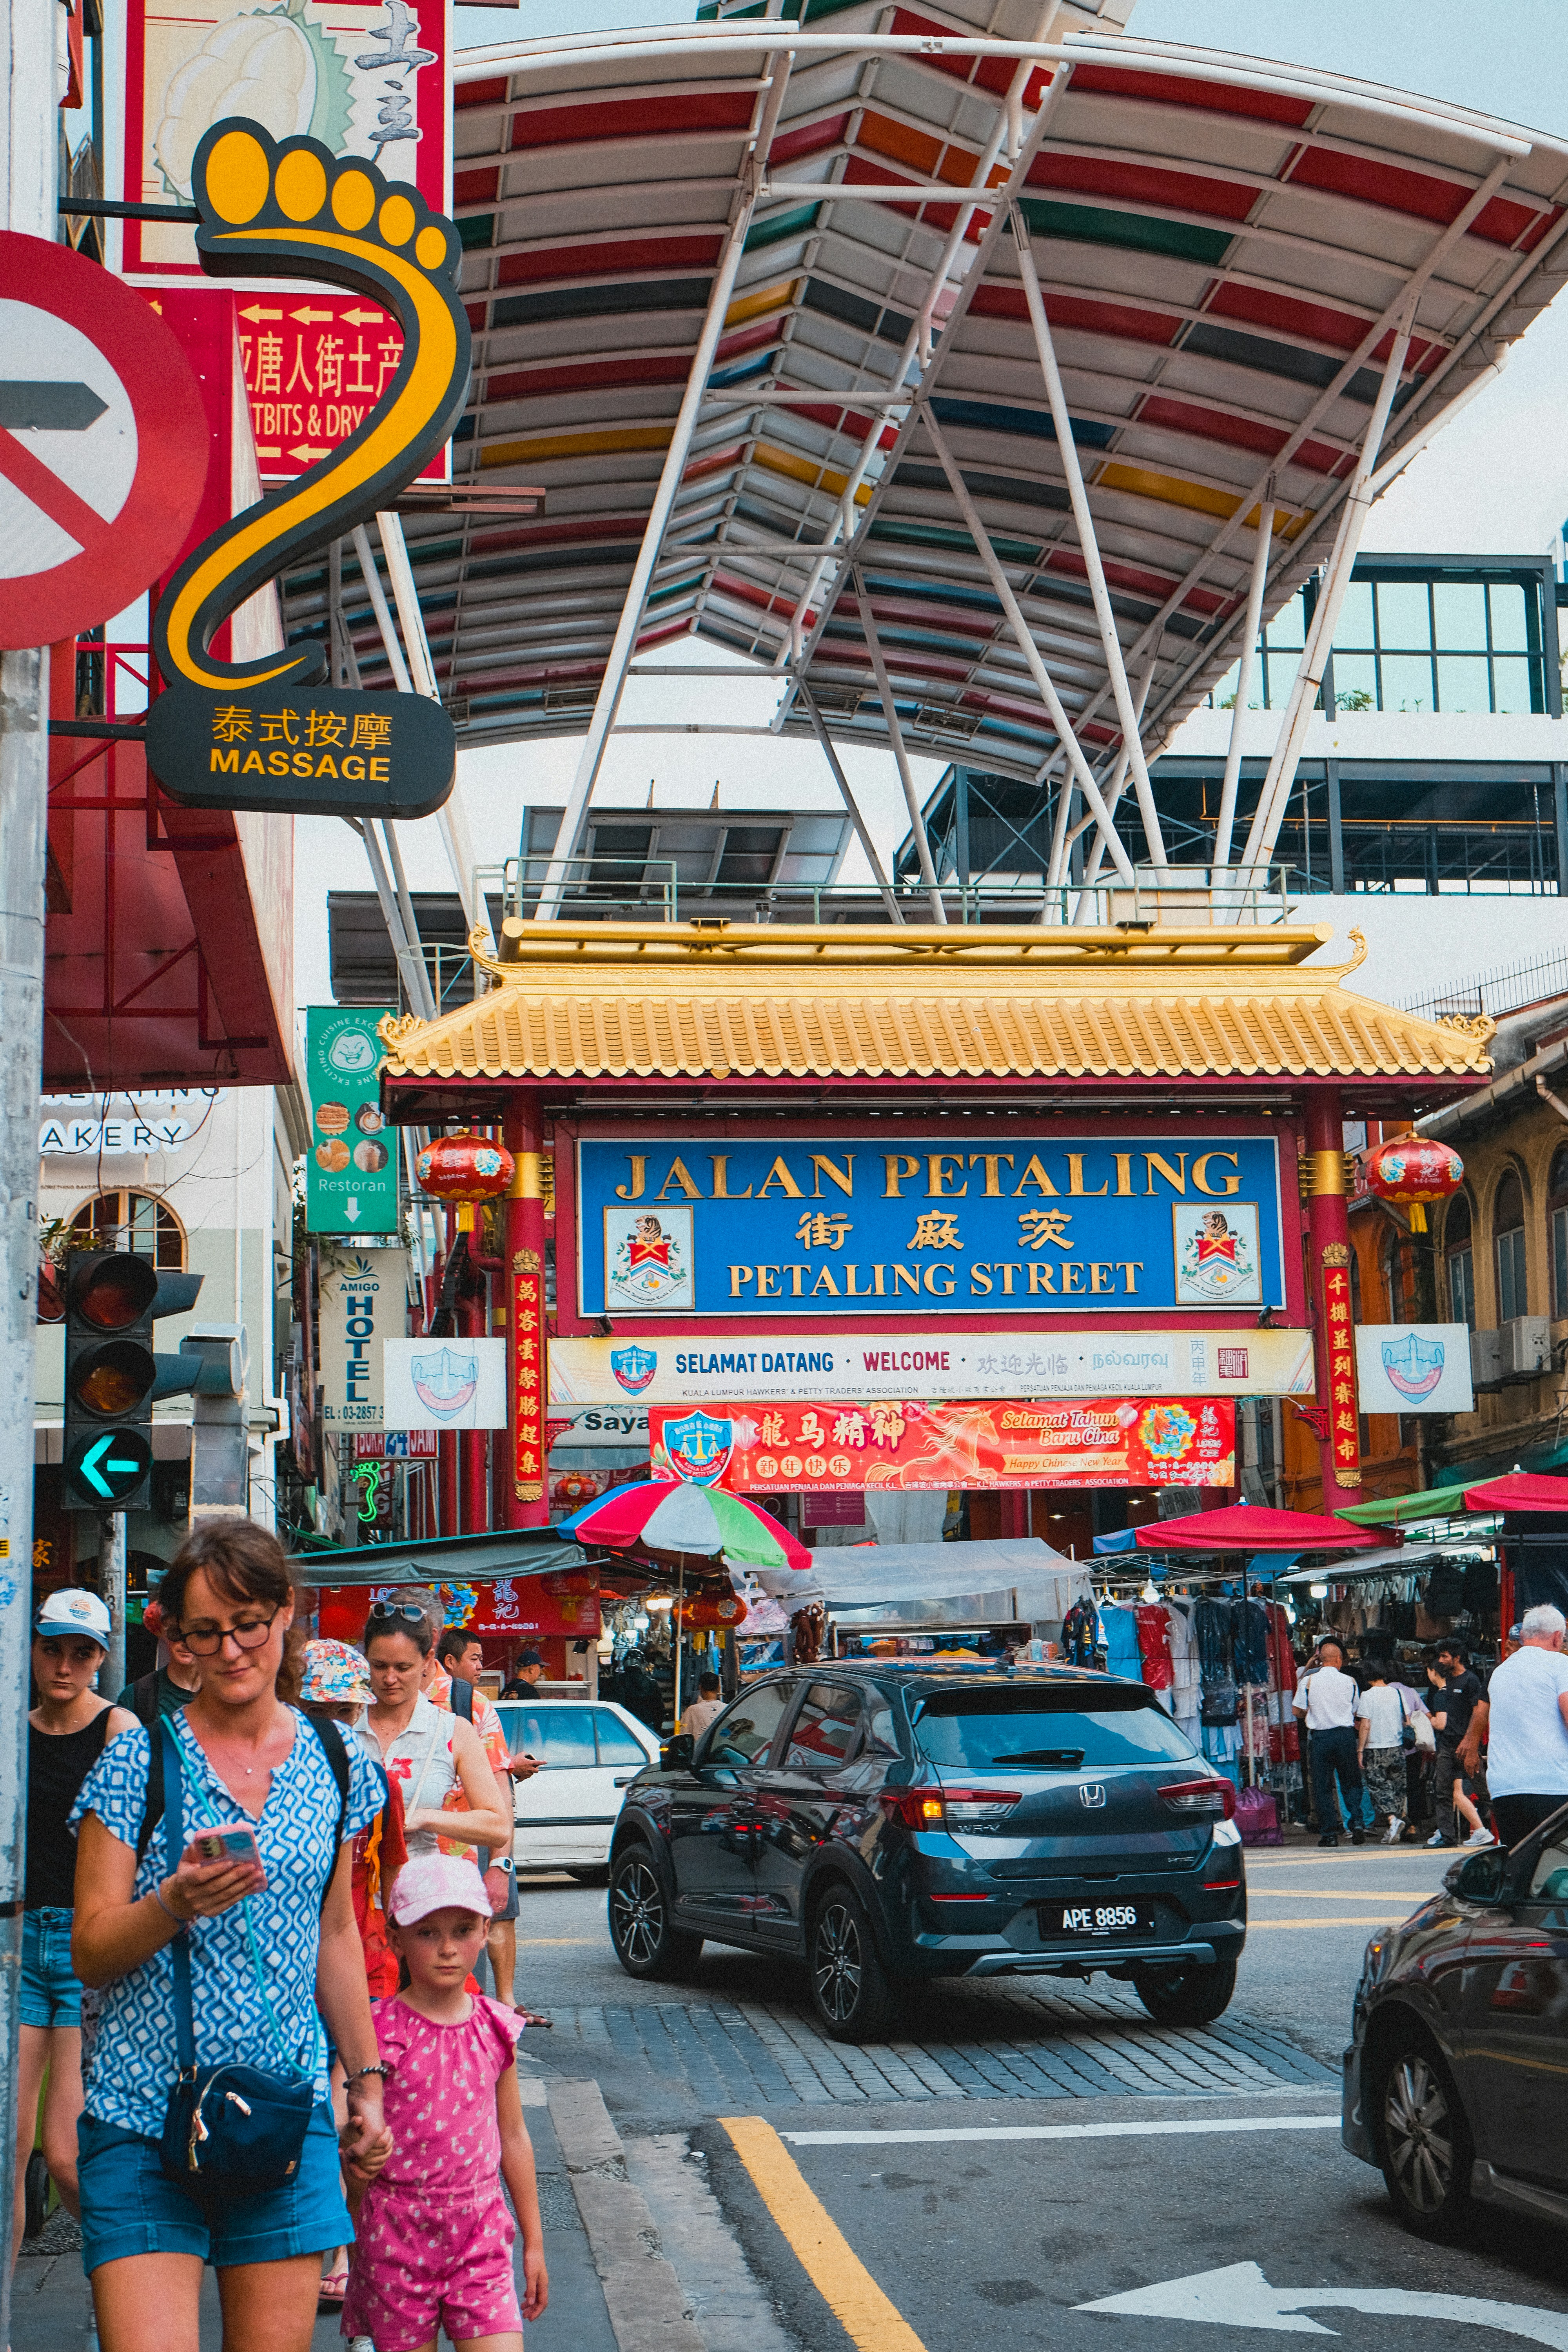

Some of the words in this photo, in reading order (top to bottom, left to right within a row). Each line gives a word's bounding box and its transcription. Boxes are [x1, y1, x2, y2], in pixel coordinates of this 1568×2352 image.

[307, 404, 322, 437] &
[326, 405, 364, 437] DRY
[212, 705, 392, 750] 泰式按摩
[210, 748, 390, 782] MASSAGE
[318, 1018, 350, 1045] CUISINE
[319, 1178, 386, 1192] Restoran
[615, 1154, 858, 1200] JALAN
[880, 1152, 1243, 1199] PETALING
[339, 1283, 380, 1292] AMIGO
[727, 1263, 958, 1297] PETALING
[970, 1262, 1143, 1296] STREET
[345, 1295, 374, 1402] HOTEL
[676, 1353, 757, 1373] SELAMAT
[762, 1352, 833, 1372] DATANG
[863, 1351, 950, 1371] WELCOME
[977, 1352, 1069, 1376] 欢迎光临
[1093, 1350, 1169, 1370] நல்வரவு
[1190, 1340, 1207, 1387] 丙申年
[325, 1406, 335, 1419] EL
[343, 1406, 376, 1420] 03-2857
[584, 1413, 650, 1434] Saya
[1002, 1411, 1068, 1428] Selamat
[1071, 1411, 1118, 1426] Tahun
[385, 1433, 408, 1456] 24
[411, 1430, 435, 1452] JAM
[1041, 1429, 1080, 1445] Baru
[1082, 1428, 1118, 1444] Cina
[760, 1458, 848, 1474] 新年快乐
[1010, 1458, 1040, 1469] Happy
[1043, 1457, 1077, 1467] Chinese
[1080, 1457, 1099, 1466] New
[1102, 1457, 1122, 1466] Year
[1085, 1478, 1129, 1486] ASSOCIATION
[958, 1824, 1000, 1833] WR-V
[1063, 1908, 1093, 1928] APE
[1095, 1906, 1137, 1926] 8856
